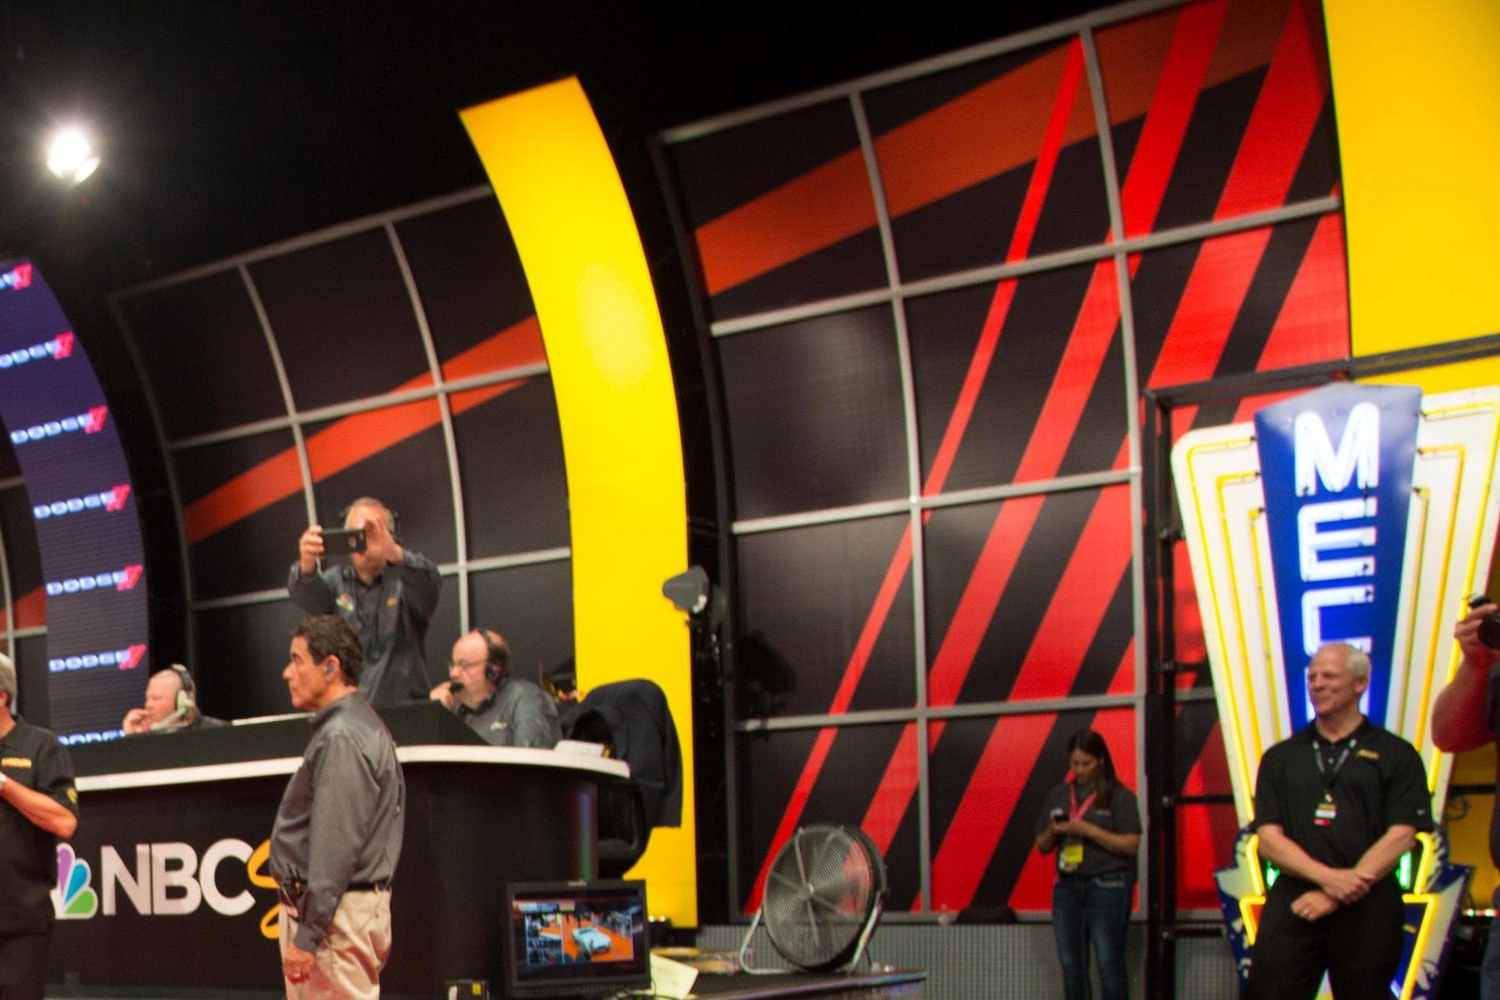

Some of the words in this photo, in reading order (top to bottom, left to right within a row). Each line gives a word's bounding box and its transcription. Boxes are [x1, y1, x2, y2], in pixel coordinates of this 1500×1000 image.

[10, 413, 94, 445] DODGE
[34, 490, 116, 519] DODGE
[1294, 401, 1379, 719] MEC
[46, 570, 129, 596] DODGE
[48, 648, 132, 672] DODGE
[102, 838, 256, 916] NBC
